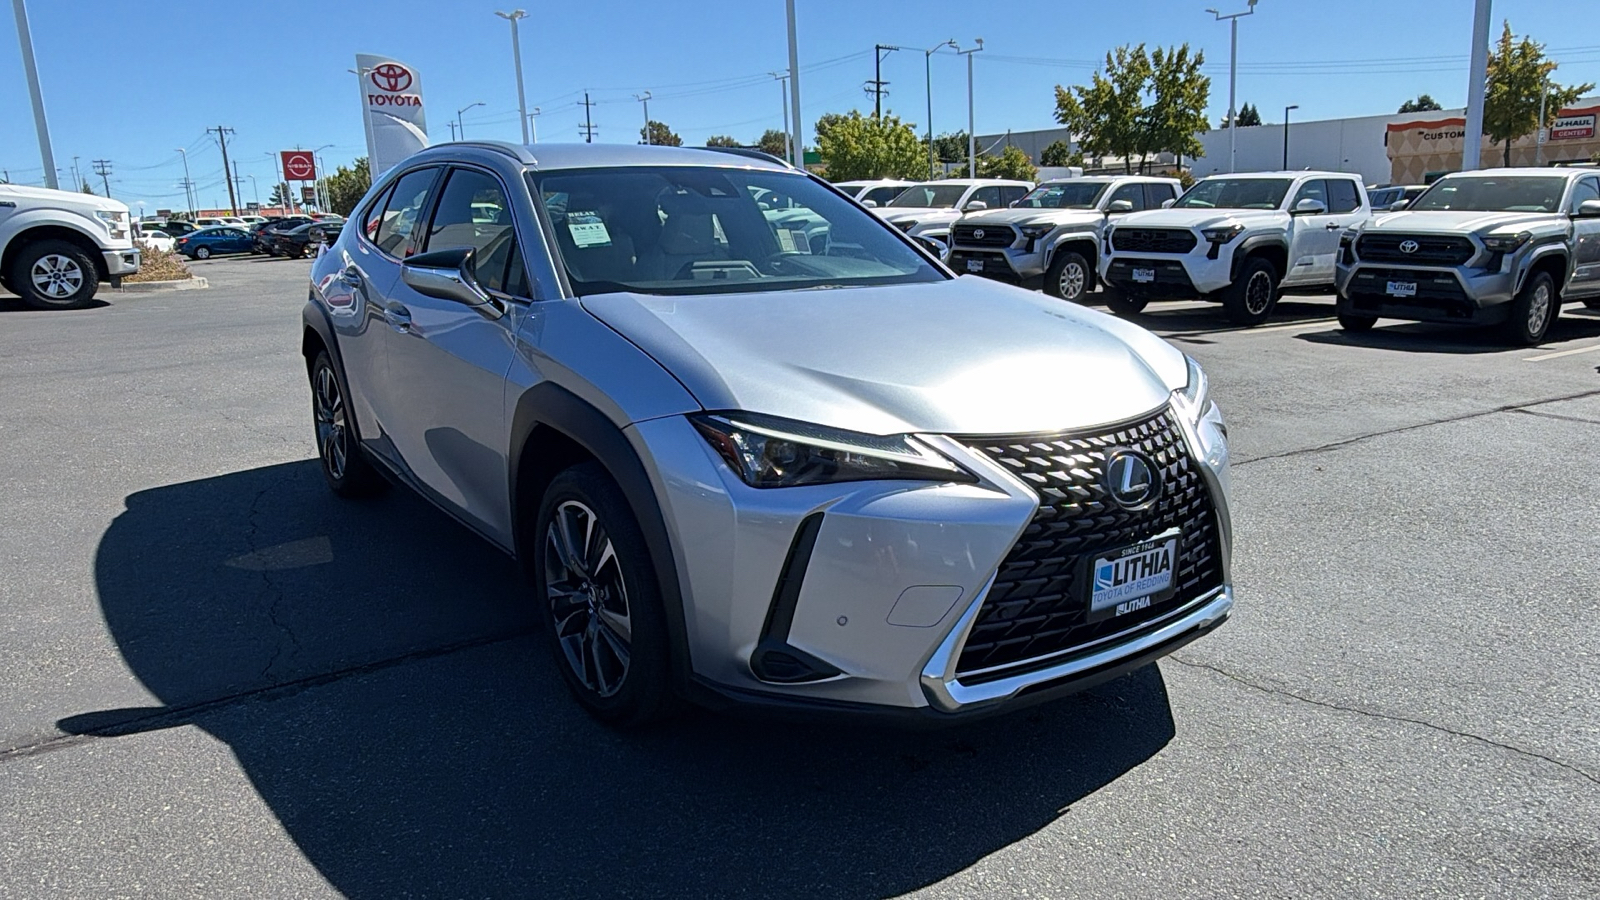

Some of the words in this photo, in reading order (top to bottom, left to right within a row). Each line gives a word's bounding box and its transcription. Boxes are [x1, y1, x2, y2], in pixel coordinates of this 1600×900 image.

[368, 94, 422, 107] TOYOTA
[1555, 119, 1592, 127] U-HAUL
[1121, 545, 1140, 557] SINCE
[1113, 548, 1170, 587] LITHIA
[1093, 589, 1122, 603] TOYOTA
[1124, 582, 1135, 595] OF
[1136, 572, 1170, 590] REDDING
[1125, 596, 1150, 613] LITHIA
